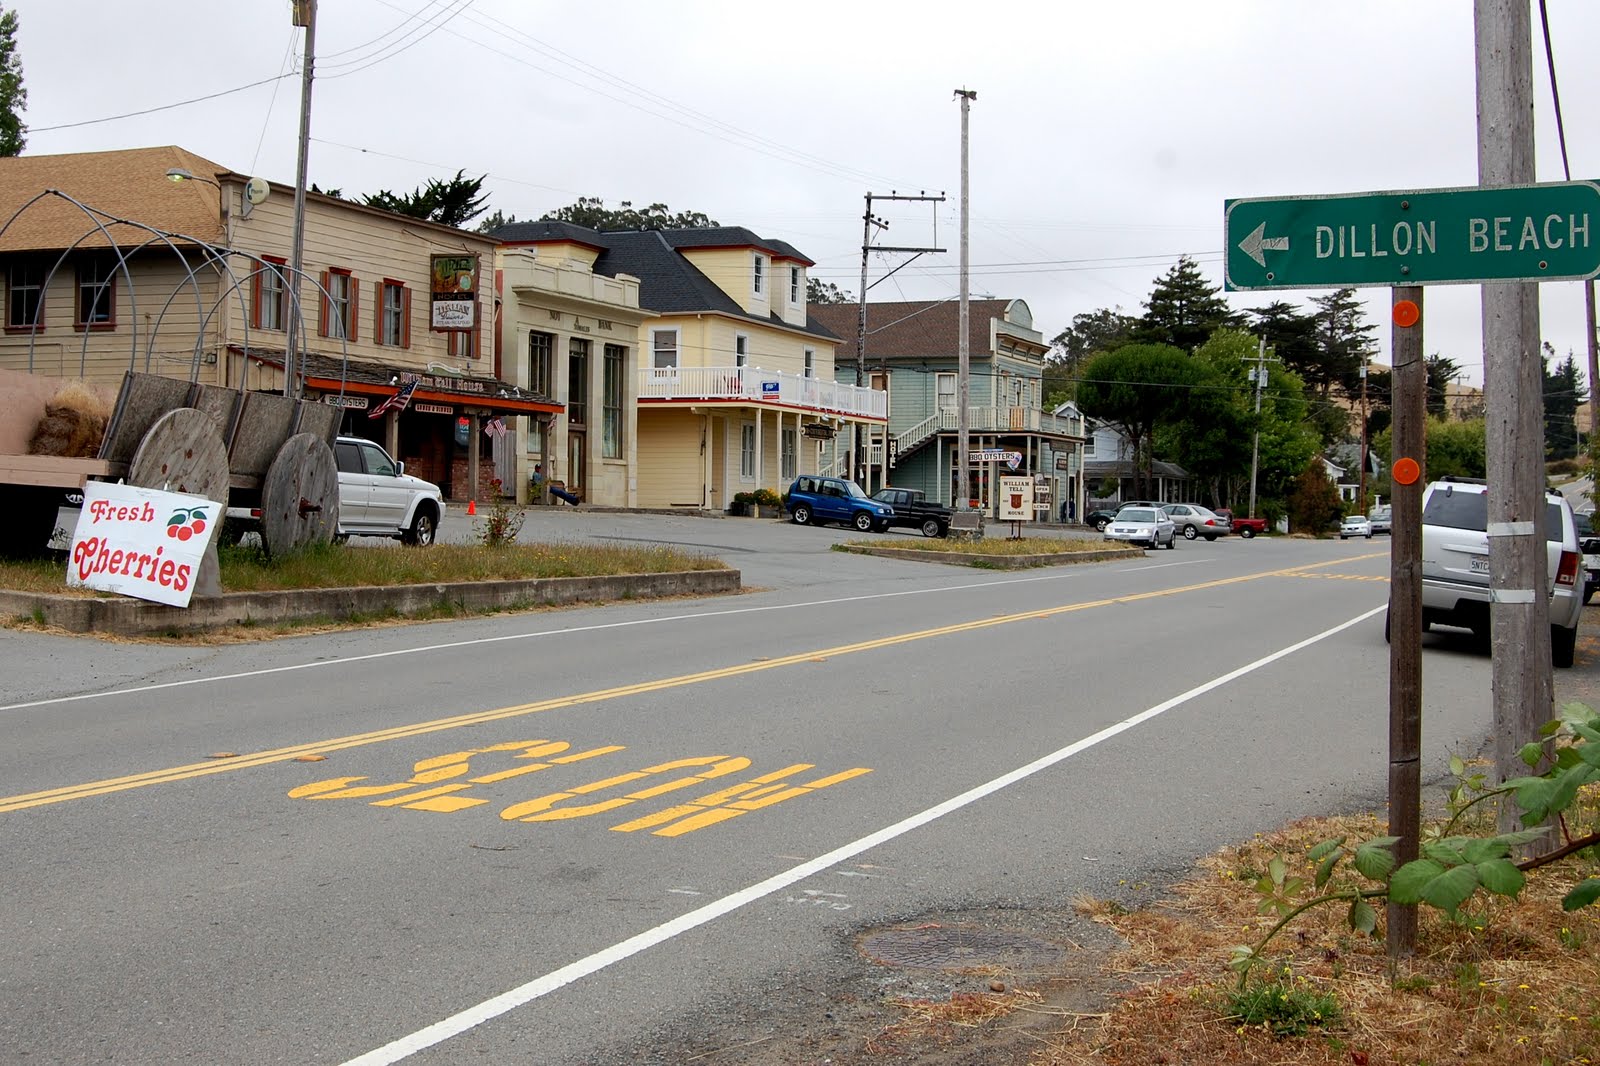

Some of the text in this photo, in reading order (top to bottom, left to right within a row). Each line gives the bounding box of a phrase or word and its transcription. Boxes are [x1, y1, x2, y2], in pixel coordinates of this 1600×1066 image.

[1315, 212, 1590, 259] DILLON BEACH
[970, 452, 1015, 461] BBQ OYSTERS
[90, 500, 155, 524] Fresh
[74, 536, 191, 592] Cherries
[1470, 560, 1490, 571] 5NTC
[287, 739, 874, 837] SLOW
